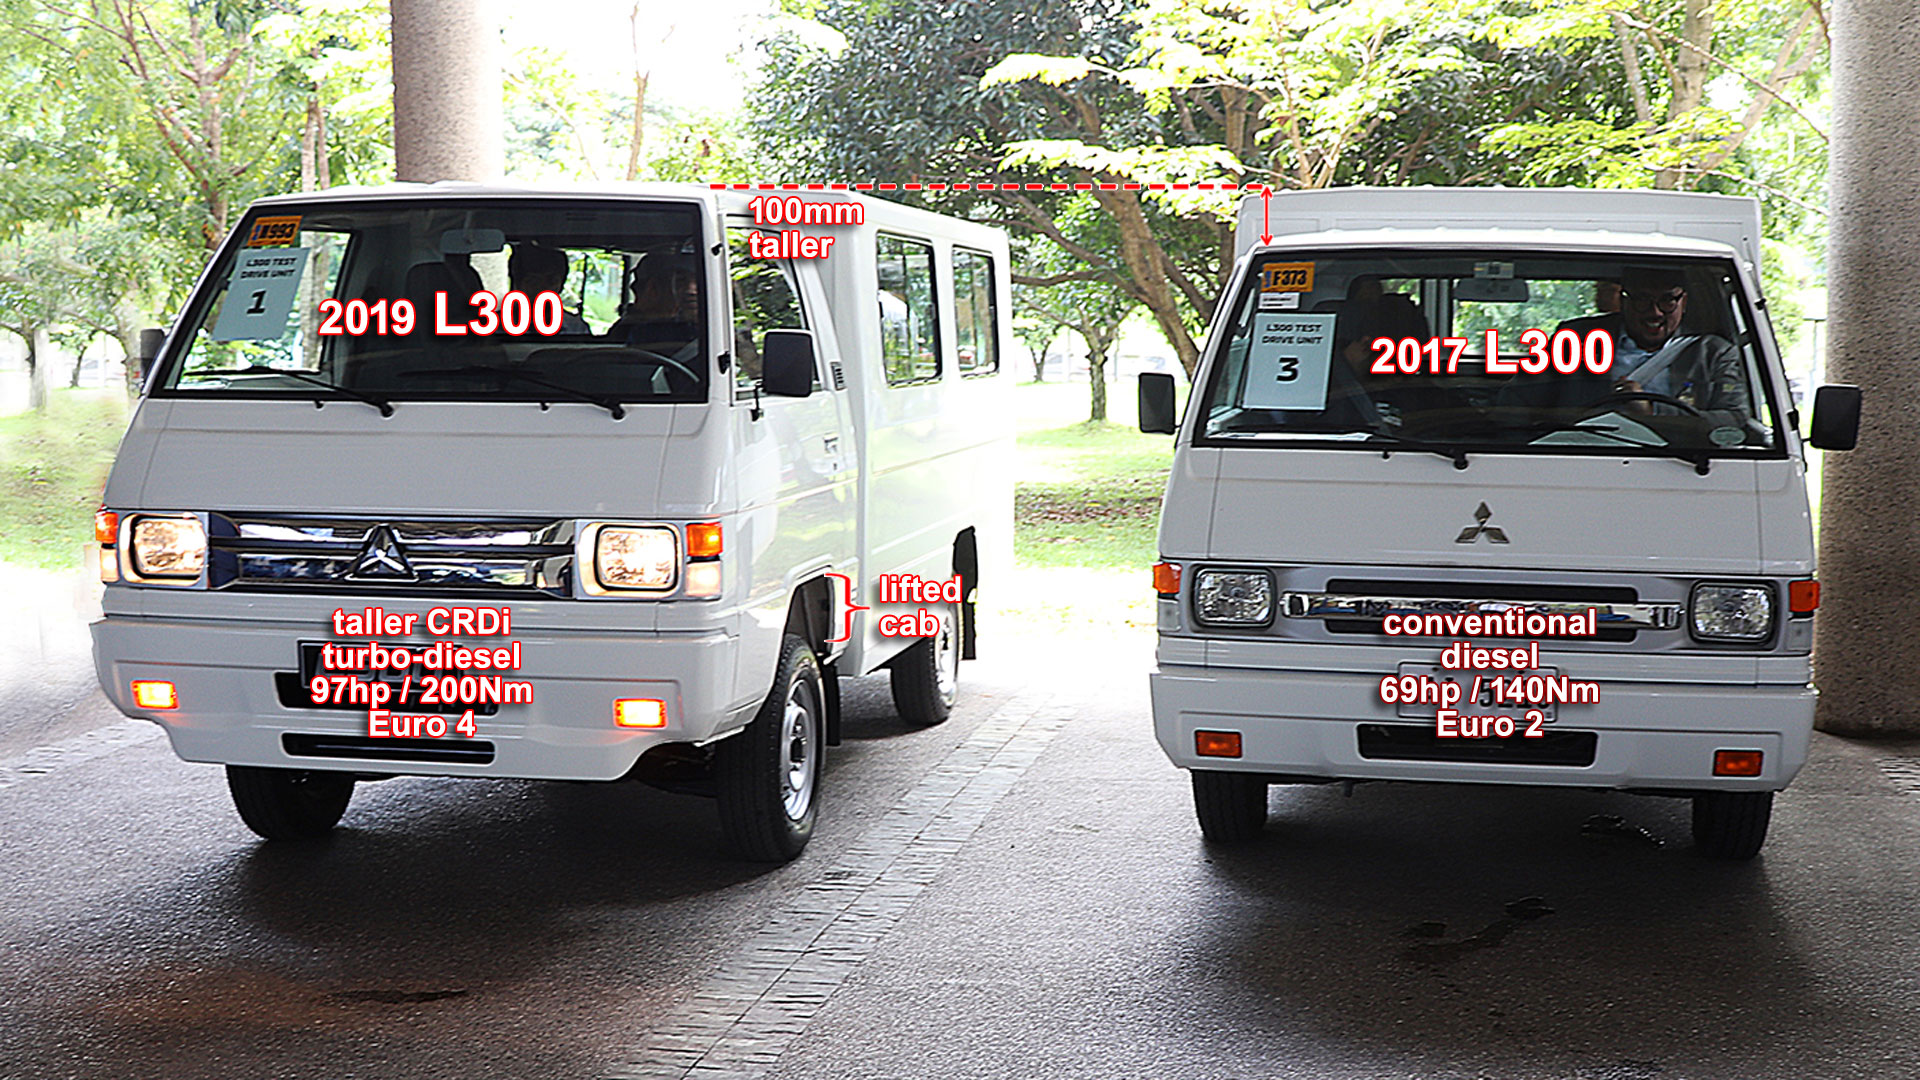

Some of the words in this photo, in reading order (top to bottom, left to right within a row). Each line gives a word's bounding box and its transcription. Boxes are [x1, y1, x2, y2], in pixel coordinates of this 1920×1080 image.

[272, 258, 297, 266] TEST
[271, 270, 295, 278] UNIT
[1273, 270, 1307, 286] F373
[246, 289, 267, 314] 1
[1267, 324, 1292, 332] L300
[1296, 324, 1323, 332] TEST
[1262, 335, 1295, 344] DRIVE
[1296, 335, 1323, 344] UNIT
[1276, 357, 1300, 382] 3
